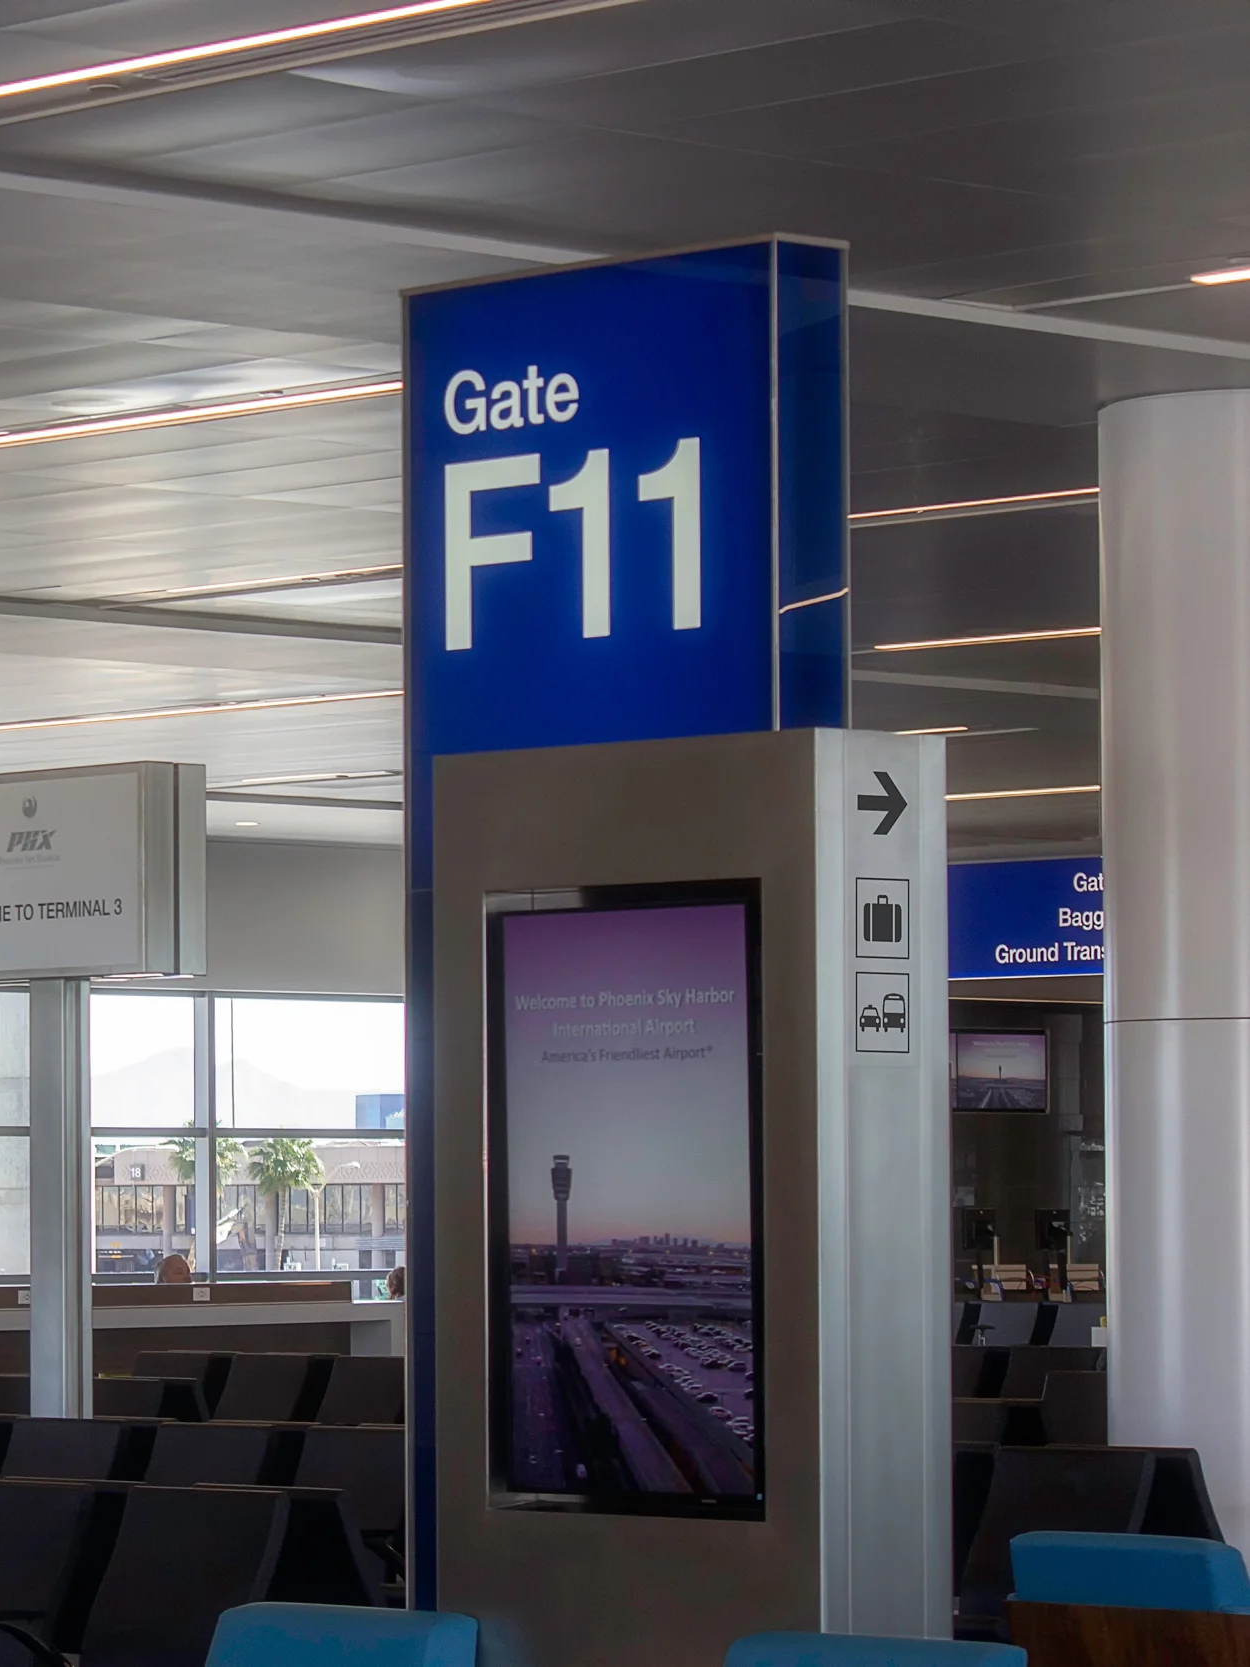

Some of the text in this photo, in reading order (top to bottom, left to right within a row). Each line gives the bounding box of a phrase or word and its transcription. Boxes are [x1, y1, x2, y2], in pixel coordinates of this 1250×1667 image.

[444, 365, 580, 435] Gate
[444, 437, 702, 651] F11
[6, 829, 57, 852] PHX
[14, 903, 34, 921] TO
[38, 899, 110, 920] TERMINAL
[114, 898, 123, 915] 3
[995, 941, 1105, 964] Ground Tran
[515, 985, 736, 1011] Welcome to Phoenix Sky Harbor
[553, 1017, 696, 1038] International Airport
[541, 1048, 596, 1063] America's
[599, 1045, 660, 1061] Friendliest
[130, 1167, 141, 1178] 18
